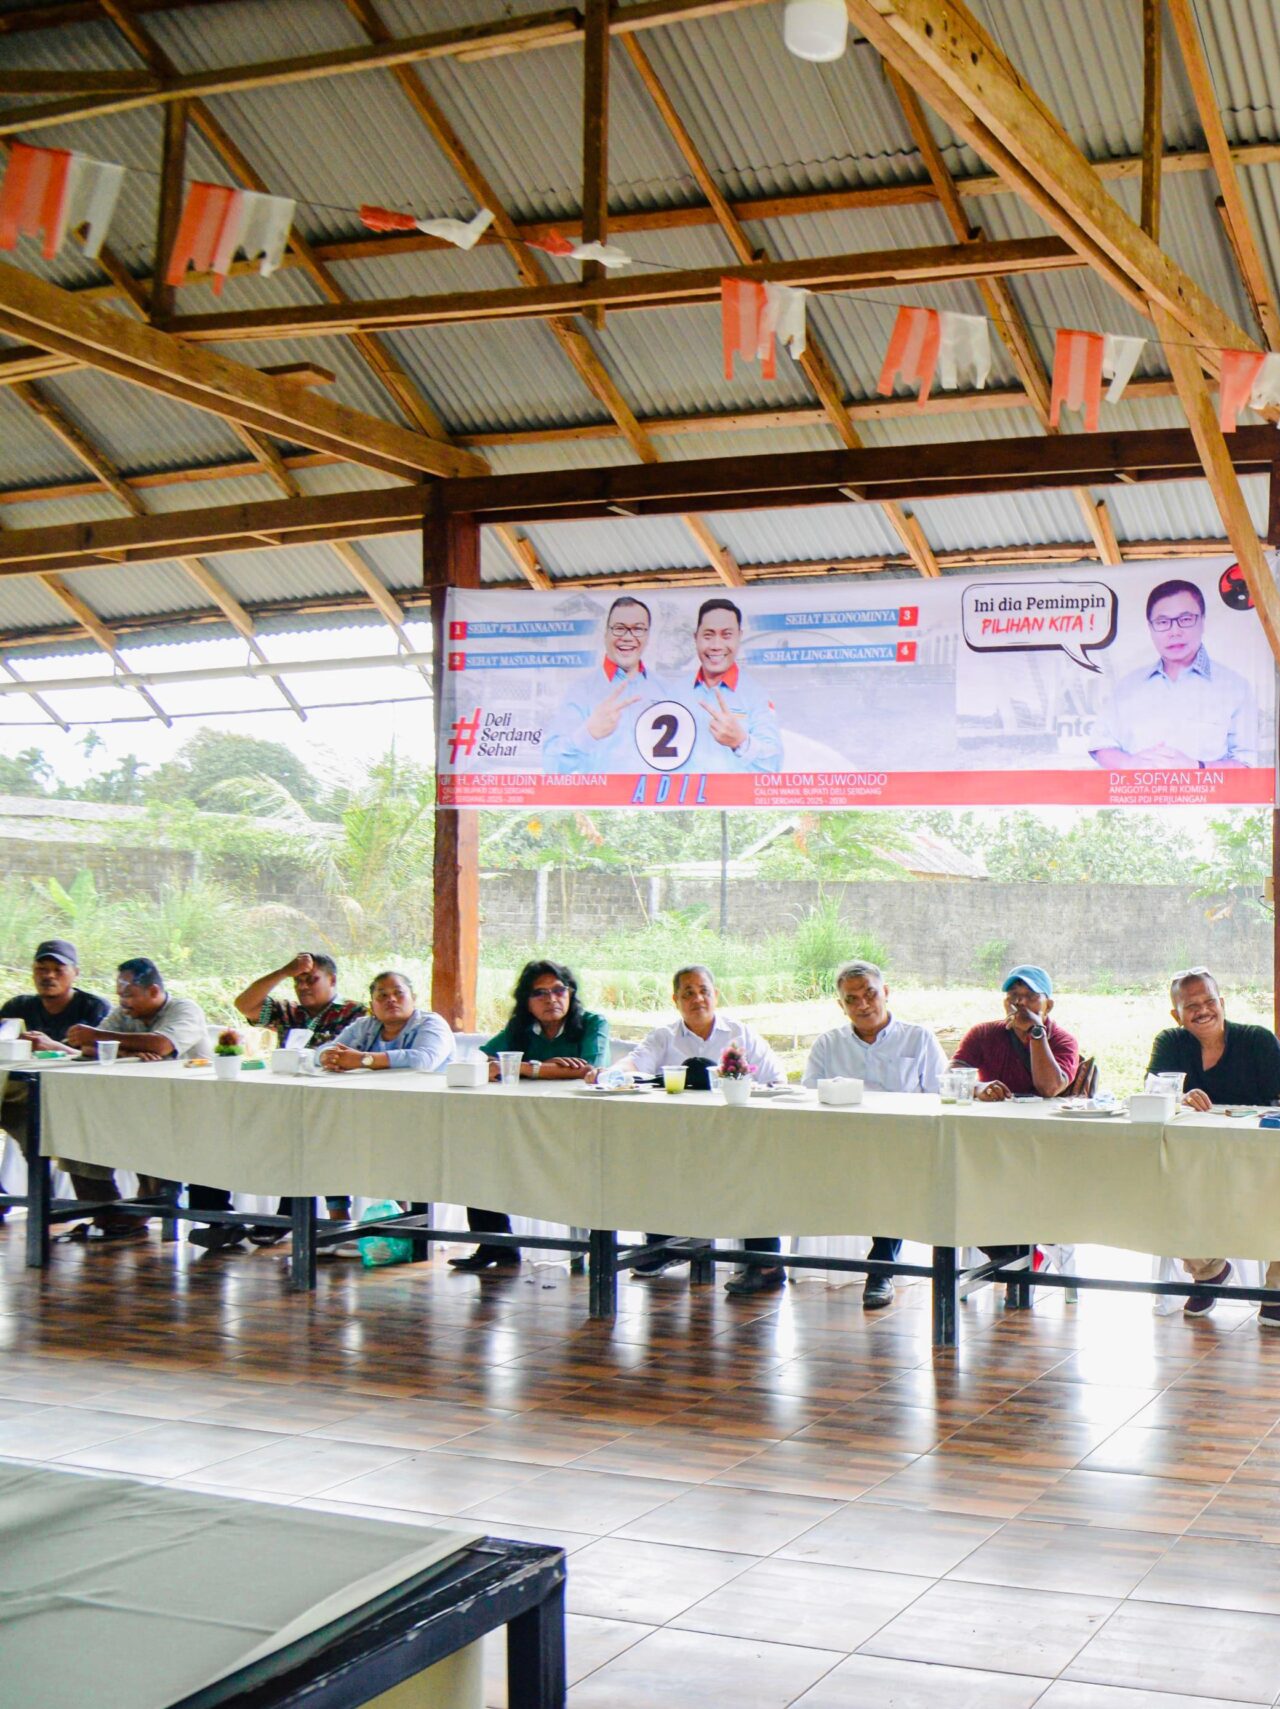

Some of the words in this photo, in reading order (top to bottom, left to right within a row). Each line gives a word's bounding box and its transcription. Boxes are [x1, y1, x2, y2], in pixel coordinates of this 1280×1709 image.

[974, 598, 995, 612] Ini
[998, 596, 1022, 611] dia
[1026, 594, 1106, 613] Pemimpin
[785, 613, 822, 625] SEHAT
[823, 611, 896, 624] EKONOMINYA
[903, 610, 911, 620] 3
[467, 623, 499, 634] SEHAT
[981, 616, 1044, 635] PILIHAN
[1049, 614, 1084, 632] KITA
[763, 650, 800, 662] SEHAT
[801, 647, 894, 660] LINGKUNGANNYA
[901, 645, 909, 656] 4
[466, 656, 498, 666] SEHAT
[484, 713, 512, 726] Deli
[481, 728, 542, 744] Serdang
[651, 714, 679, 758] 2
[477, 743, 518, 756] Sehat
[472, 775, 498, 786] ASRI
[501, 775, 537, 786] LUDIN
[541, 774, 607, 786] TAMBUNAN
[754, 775, 782, 786] LOM
[786, 775, 814, 786] LOM
[818, 774, 888, 786] SUWONDO
[1109, 773, 1130, 785] Dr.
[1134, 772, 1191, 785] SOFYAN
[1195, 772, 1225, 785] TAN
[632, 774, 708, 804] ADIL
[1180, 785, 1208, 793] KOMISI
[1109, 796, 1137, 804] FRAKSI
[1153, 795, 1207, 804] PERJUANGAN
